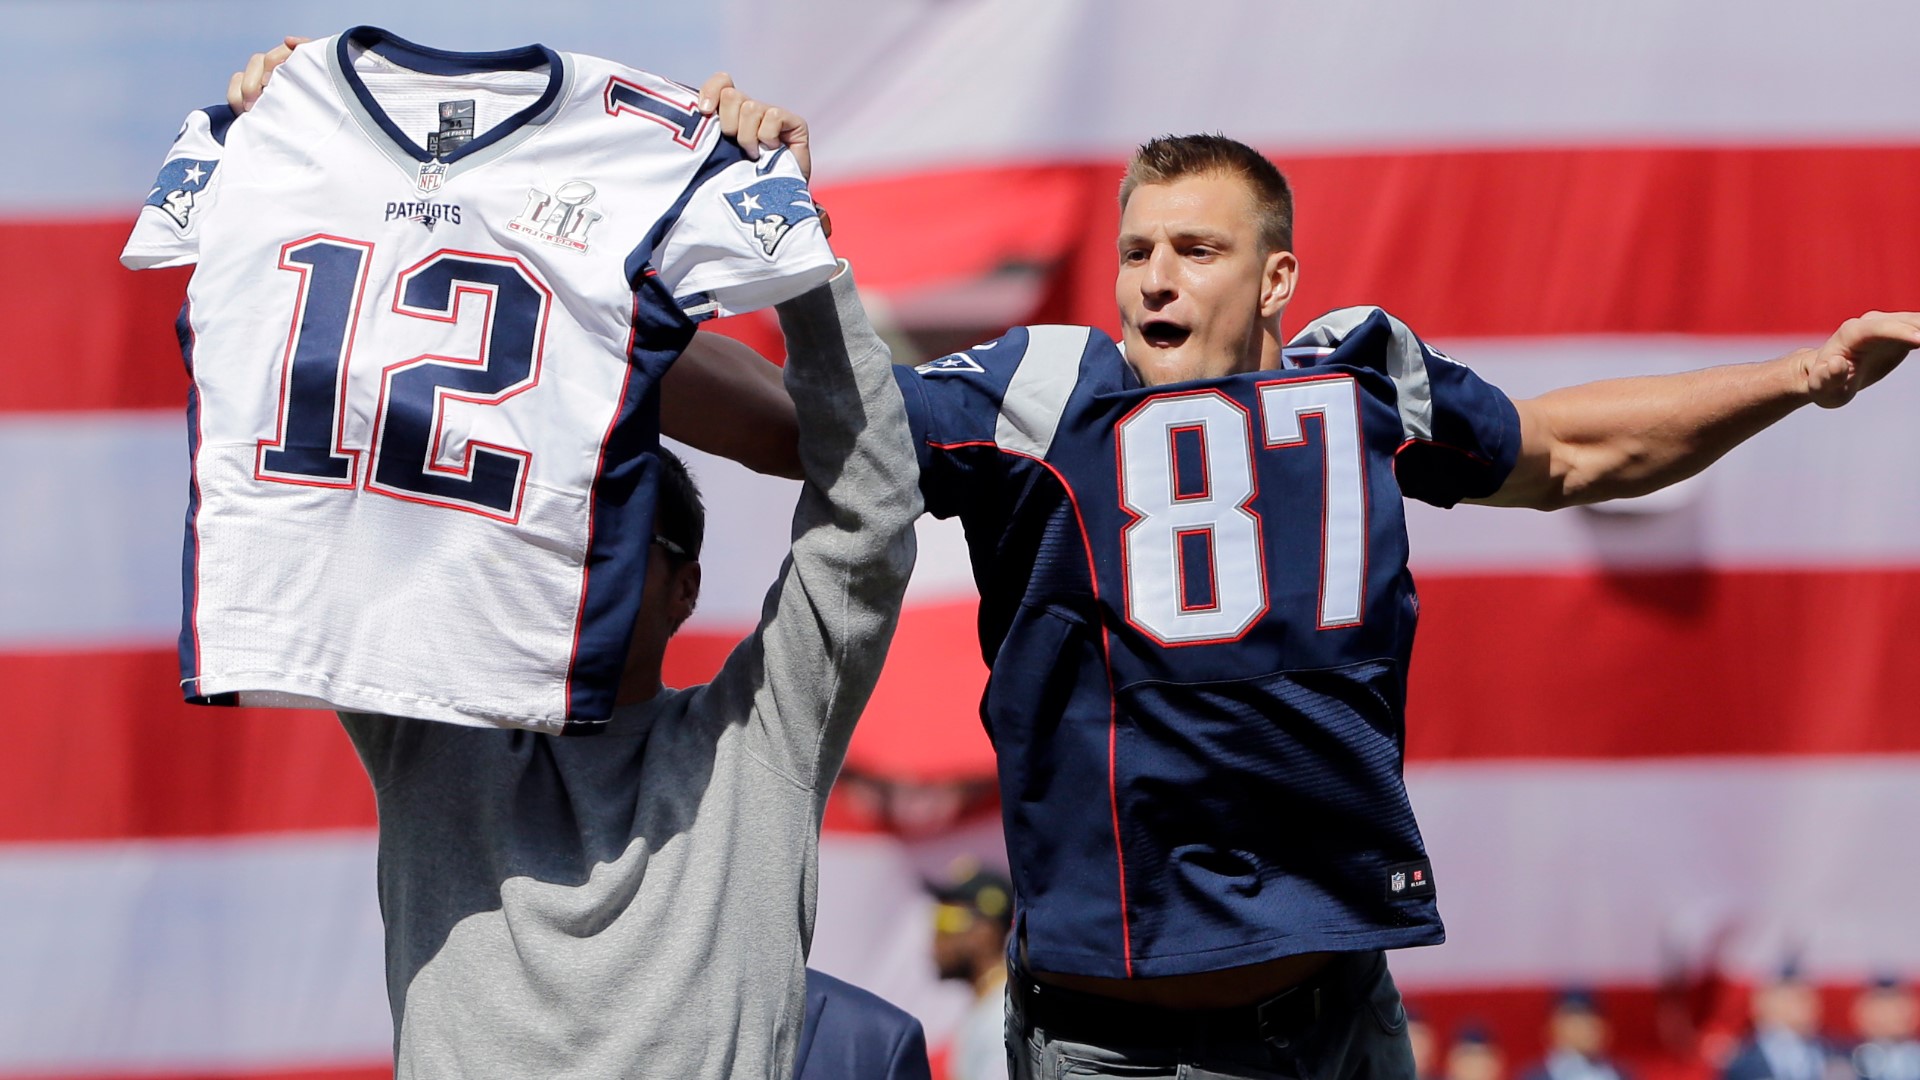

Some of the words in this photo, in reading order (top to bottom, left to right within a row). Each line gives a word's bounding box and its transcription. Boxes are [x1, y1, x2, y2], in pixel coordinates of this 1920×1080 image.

[385, 202, 461, 225] PATRIOTS
[420, 174, 440, 190] NFL
[254, 232, 553, 525] 12
[1115, 373, 1368, 647] 87
